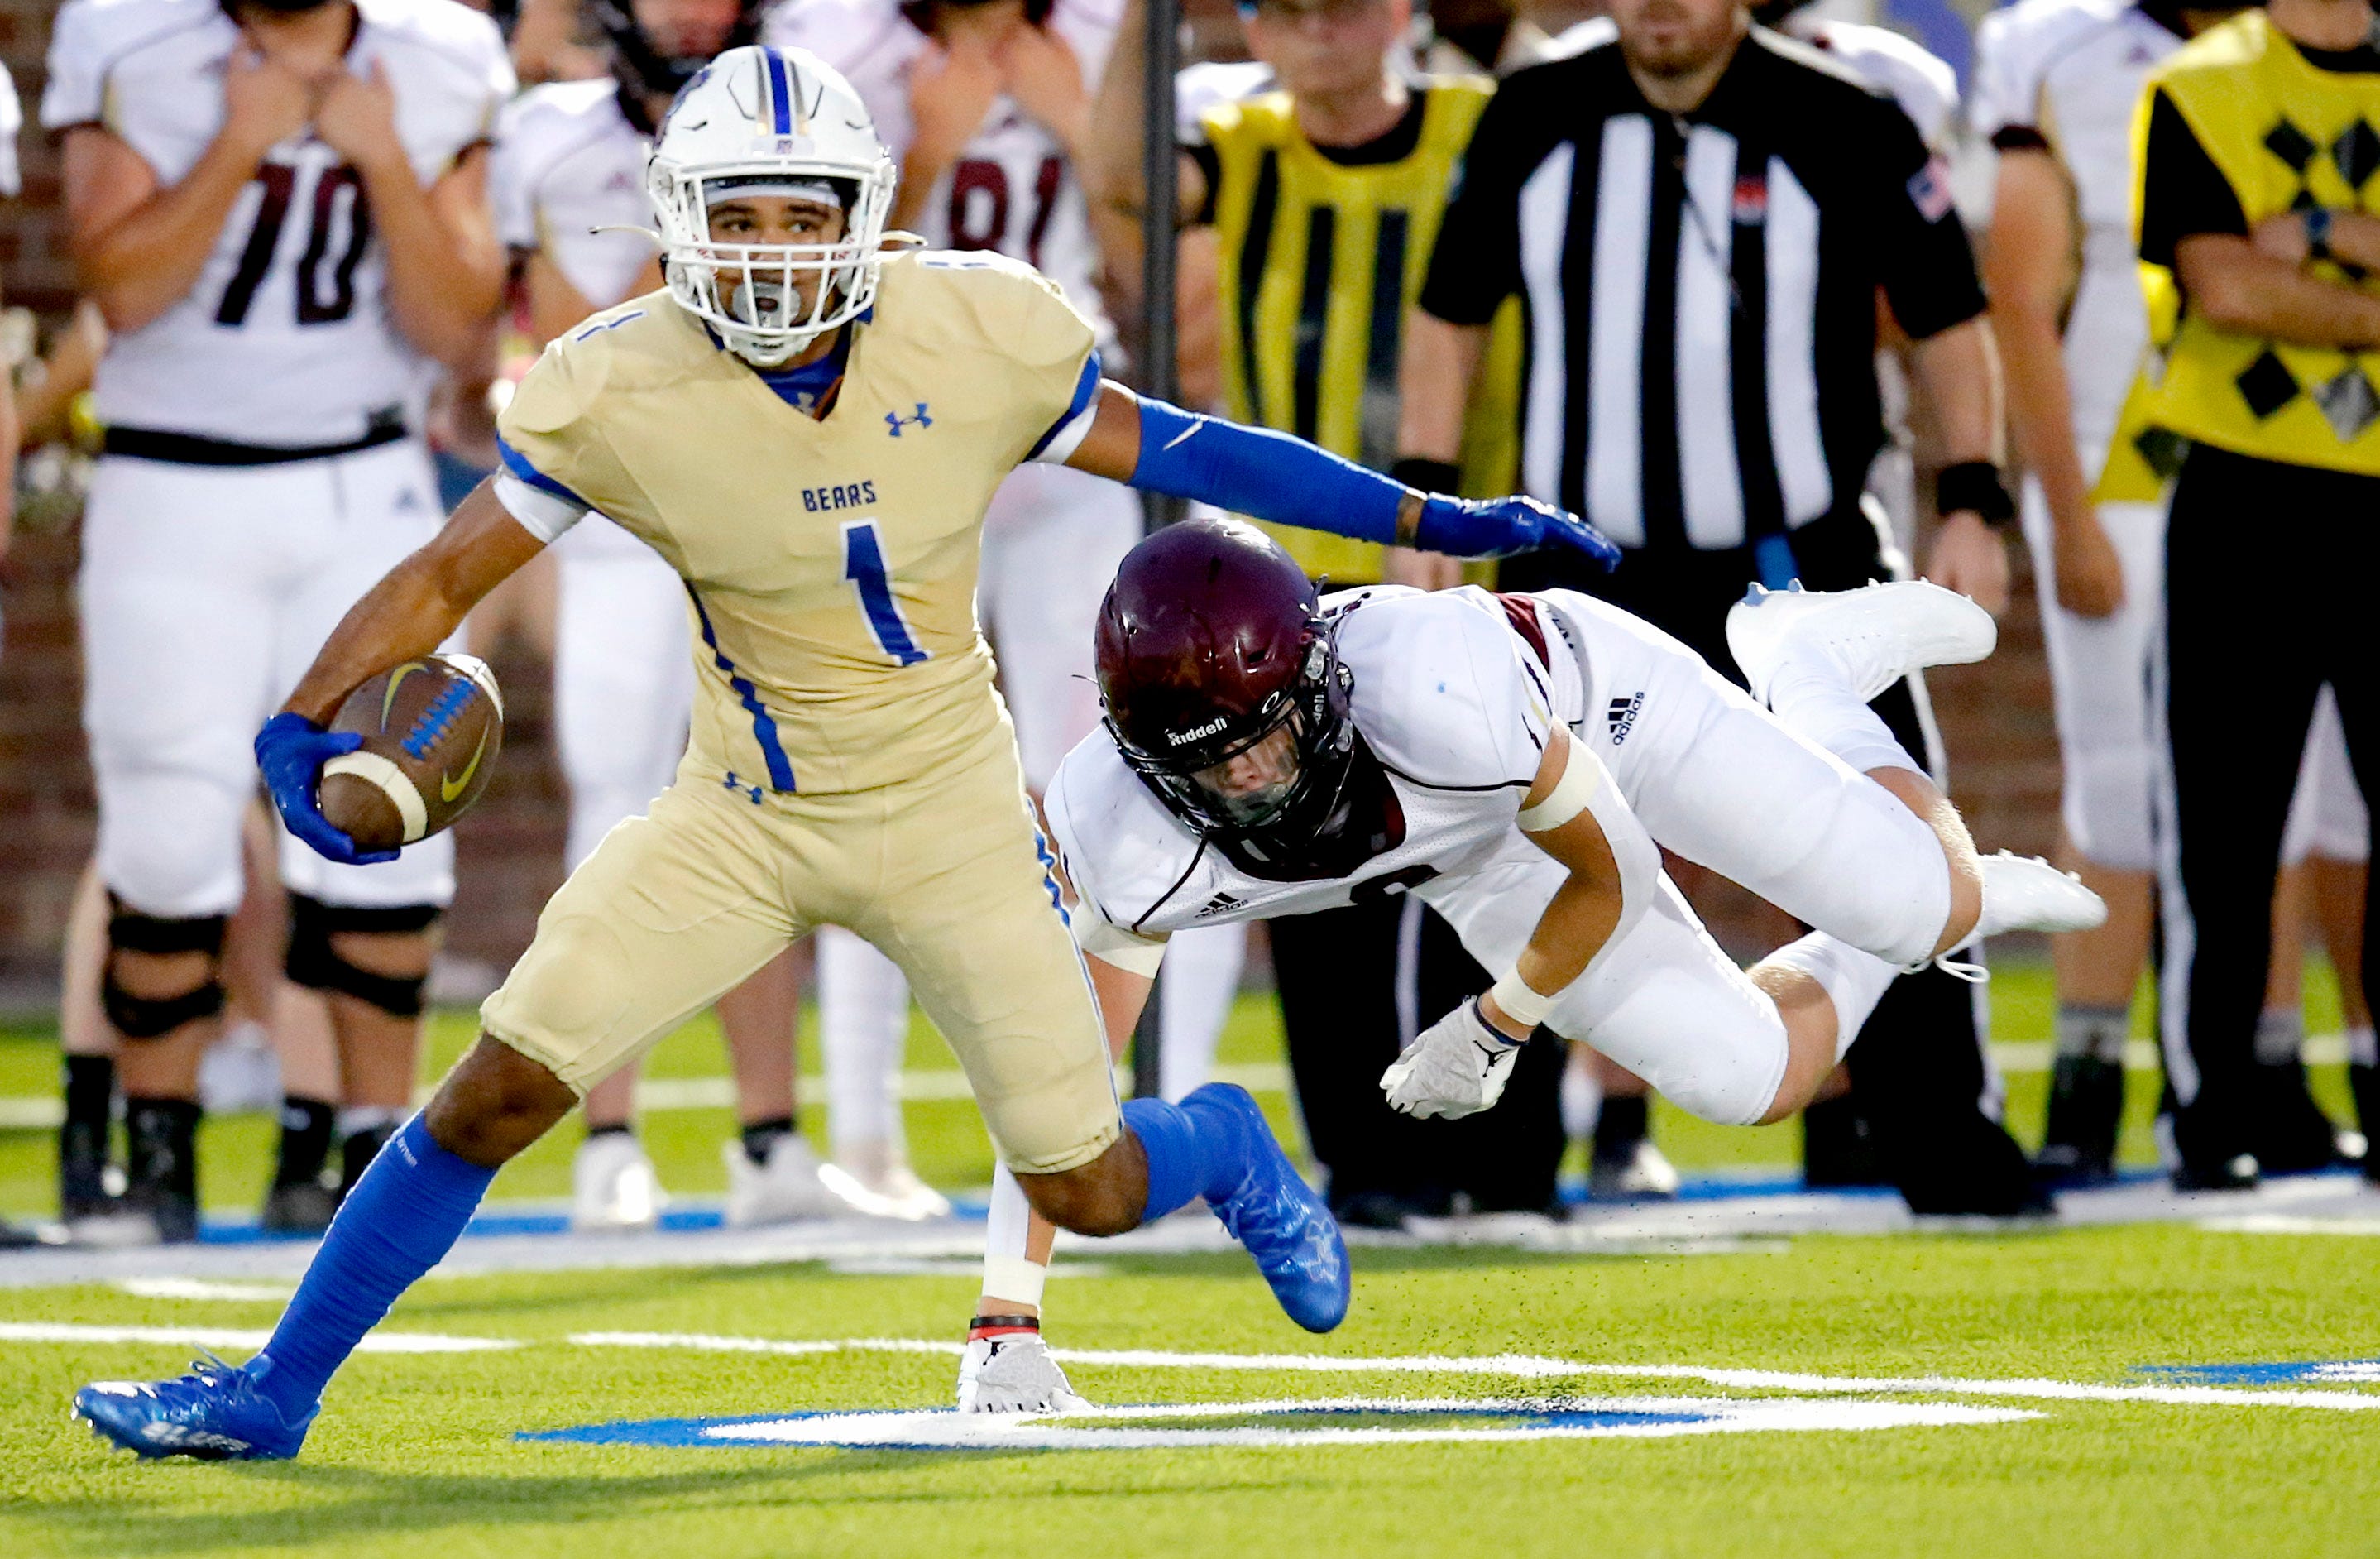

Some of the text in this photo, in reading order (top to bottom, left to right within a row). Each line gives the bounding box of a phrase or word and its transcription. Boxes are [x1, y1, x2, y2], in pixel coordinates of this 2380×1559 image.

[215, 161, 368, 324] 70
[802, 480, 876, 511] BEARS
[839, 516, 934, 666] 1
[1166, 717, 1228, 746] Riddell
[1612, 691, 1645, 746] adidas
